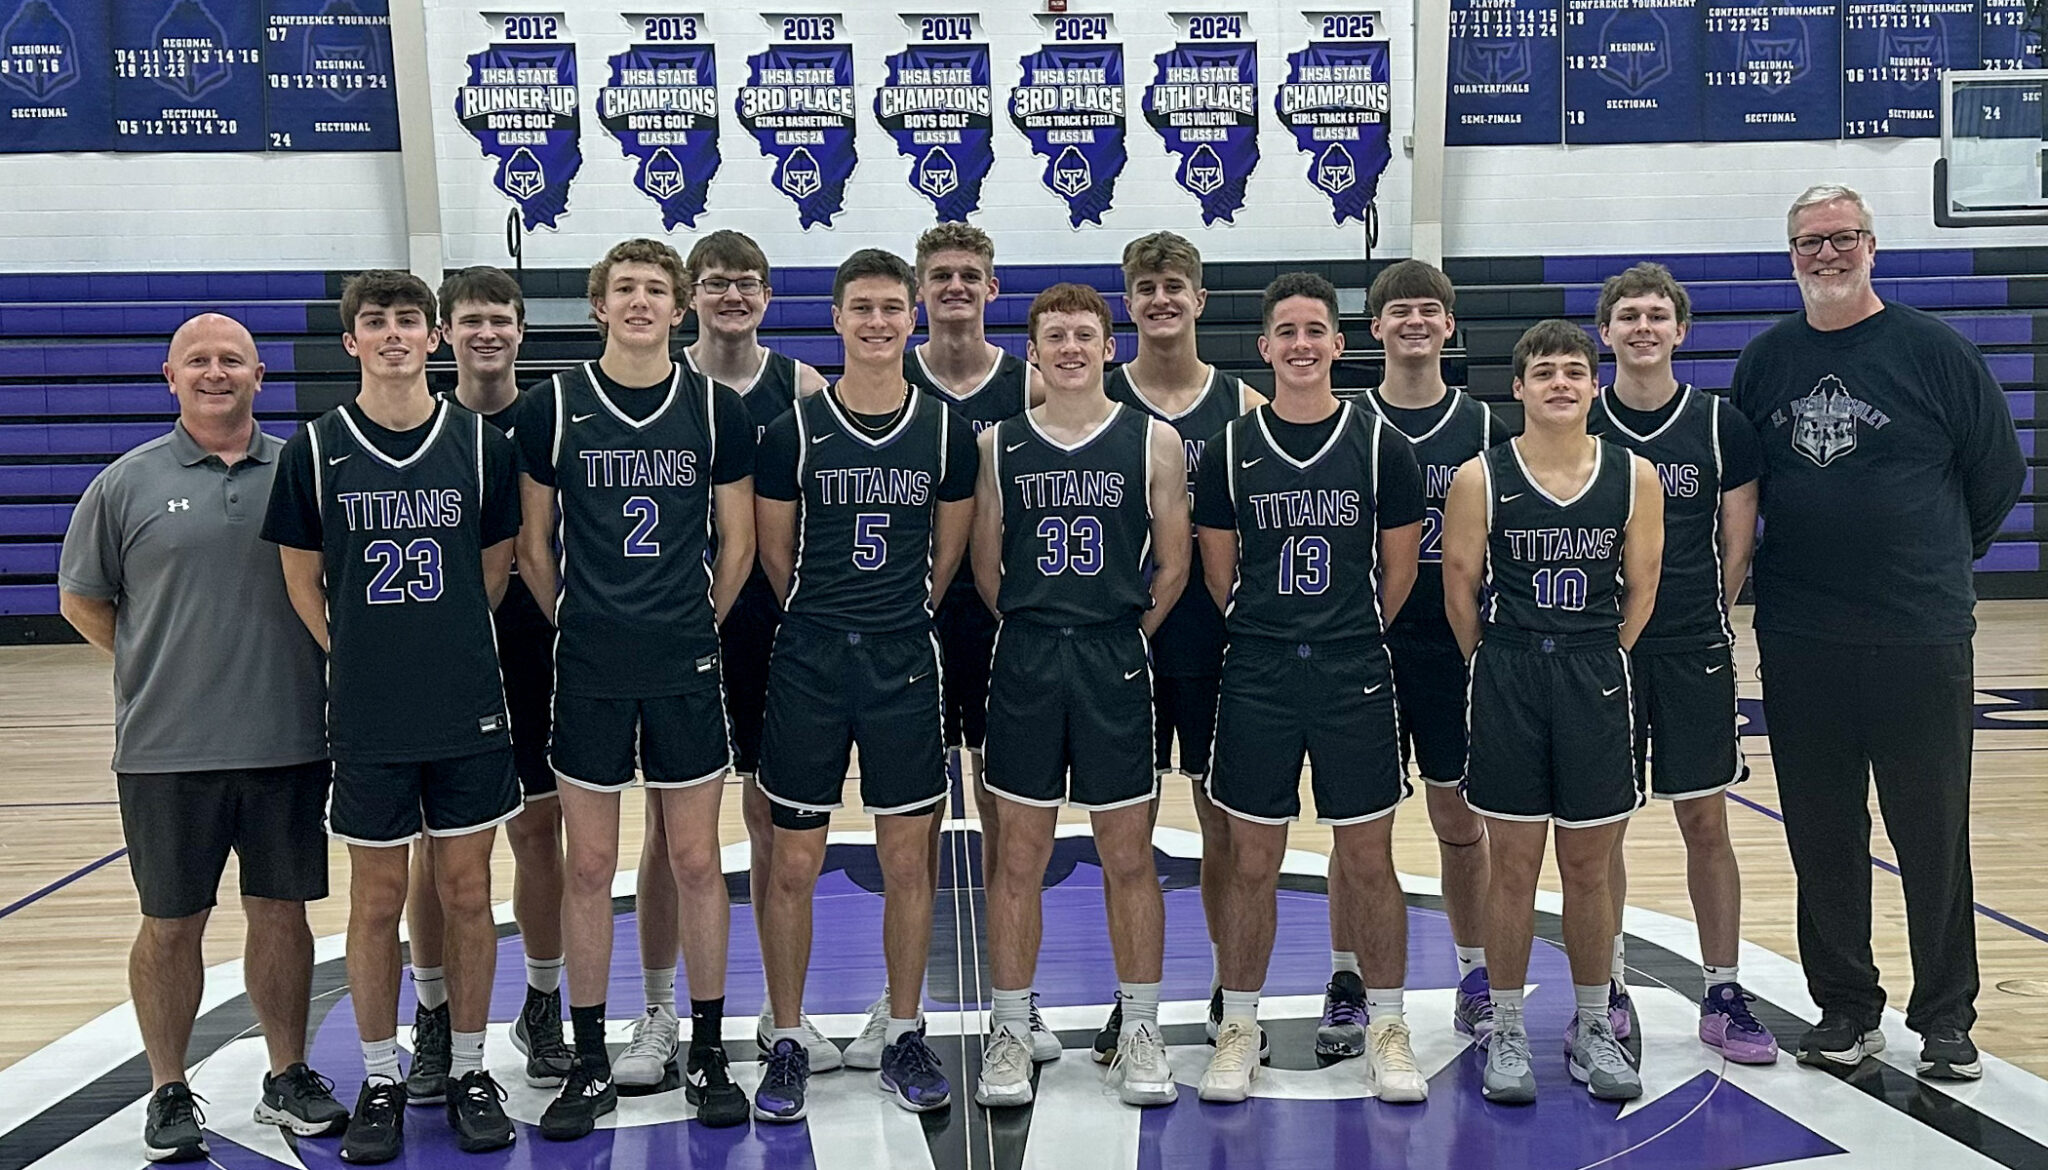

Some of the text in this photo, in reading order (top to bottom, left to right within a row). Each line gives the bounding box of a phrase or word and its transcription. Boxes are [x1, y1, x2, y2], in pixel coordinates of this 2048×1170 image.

[1470, 0, 1516, 8] PLAYOFFS
[1570, 0, 1696, 9] CONFERENCE TOURNAMENT
[1850, 4, 1974, 14] CONFERENCE TOURNAMENT
[1471, 10, 1489, 22] '10
[1493, 10, 1512, 22] '11
[1517, 10, 1534, 22] '14
[1539, 10, 1557, 22] '15
[1709, 6, 1836, 16] CONFERENCE TOURNAMENT
[270, 16, 334, 25] CONFERENCE
[1566, 12, 1584, 24] '18
[1846, 15, 1930, 28] '11 '12 '13 '14
[1984, 12, 2023, 24] '14 '23
[504, 17, 558, 40] 2012
[644, 18, 697, 40] 2013
[784, 18, 834, 40] 2013
[922, 18, 972, 40] 2014
[1056, 18, 1107, 40] 2024
[1190, 17, 1241, 39] 2024
[1324, 16, 1374, 38] 2025
[1471, 24, 1488, 37] '21
[1493, 24, 1512, 37] '22
[1517, 24, 1534, 37] '23
[1539, 24, 1557, 37] '24
[1706, 18, 1769, 32] '11 '22 '25
[267, 28, 286, 41] '07
[12, 45, 62, 54] REGIONAL
[163, 38, 212, 48] REGIONAL
[1610, 43, 1656, 52] REGIONAL
[115, 50, 258, 63] '04 '11 '12 '13 '14 '16
[1566, 56, 1606, 68] '18 '23
[1890, 58, 1932, 66] REGIONAL
[14, 59, 60, 73] '10 '16
[115, 64, 185, 78] '19 '21 '23
[316, 60, 364, 69] REGIONAL
[1748, 61, 1794, 70] REGIONAL
[482, 69, 558, 84] IHSA STATE
[622, 70, 697, 85] IHSA STATE
[761, 69, 834, 84] IHSA STATE
[900, 70, 970, 84] IHSA STATE
[1033, 68, 1106, 84] IHSA STATE
[1167, 67, 1239, 83] IHSA STATE
[1300, 66, 1372, 82] IHSA STATE
[1706, 72, 1791, 85] '11 '19 '20 '22
[1846, 68, 1928, 81] '06 '11 '12 '13
[268, 75, 387, 88] '09 '12 '18 '19 '24
[1454, 84, 1530, 94] QUARTERFINALS
[464, 87, 577, 117] RUNNER-UP
[604, 87, 716, 117] CHAMPIONS
[744, 87, 853, 117] 3RD PLACE
[882, 87, 990, 116] CHAMPIONS
[1016, 86, 1124, 116] 3RD PLACE
[1154, 85, 1254, 116] 4TH PLACE
[1283, 85, 1388, 114] CHAMPIONS
[1606, 100, 1658, 108] SECTIONAL
[12, 108, 68, 118] SECTIONAL
[162, 109, 218, 118] SECTIONAL
[1170, 112, 1238, 126] GIRLS VOLLEYBALL
[1292, 112, 1380, 124] GIRLS TRACK FIELD
[1461, 114, 1522, 124] SEMI-FINALS
[1567, 111, 1584, 124] '18
[1745, 114, 1796, 122] SECTIONAL
[1889, 110, 1934, 118] SECTIONAL
[1983, 106, 2000, 119] '24
[117, 120, 237, 134] '05 '12 '13 '14 '20
[315, 122, 370, 132] SECTIONAL
[488, 114, 556, 129] BOYS GOLF
[628, 116, 695, 130] BOYS GOLF
[755, 116, 844, 128] GIRLS BASKETBALL
[904, 114, 968, 128] BOYS GOLF
[1026, 115, 1115, 126] GIRLS TRACK FIELD
[1846, 120, 1888, 134] '13 '14
[270, 133, 291, 146] '24
[498, 132, 532, 145] CLASS
[638, 132, 671, 145] CLASS
[776, 131, 808, 144] CLASS
[914, 131, 946, 144] CLASS
[1048, 130, 1080, 143] CLASS
[1180, 129, 1212, 142] CLASS
[1313, 128, 1344, 140] CLASS
[1771, 408, 1788, 429] EL
[580, 450, 696, 488] TITANS
[816, 467, 931, 506] TITANS
[1015, 470, 1124, 509] TITANS
[338, 489, 462, 530] TITANS
[1249, 490, 1360, 529] TITANS
[623, 496, 660, 557] 2
[852, 514, 890, 570] 5
[1036, 516, 1104, 576] 33
[1504, 528, 1617, 561] TITANS
[364, 538, 444, 604] 23
[1278, 536, 1330, 594] 13
[1532, 568, 1587, 611] 10
